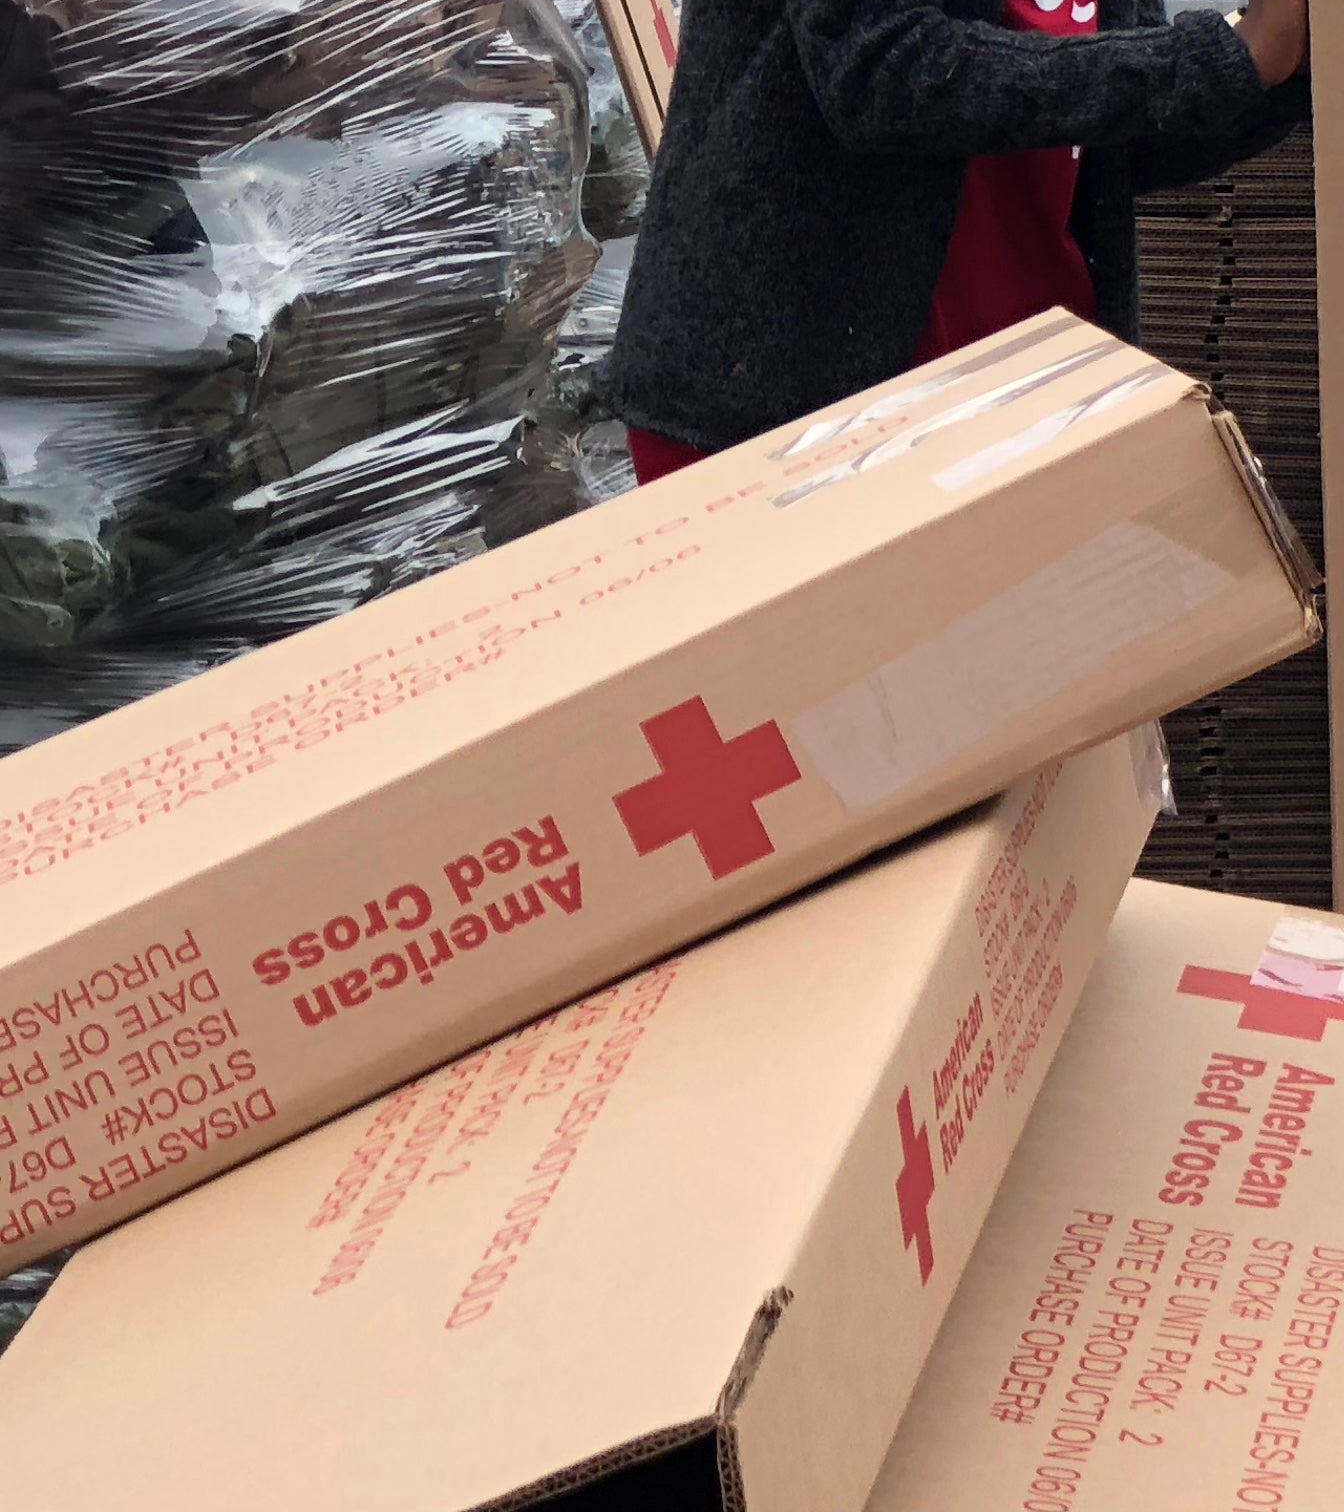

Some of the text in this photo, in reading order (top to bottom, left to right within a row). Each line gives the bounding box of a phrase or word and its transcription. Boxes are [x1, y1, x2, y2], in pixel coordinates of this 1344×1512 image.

[252, 814, 570, 986] Red Cross
[293, 861, 584, 1027] American
[59, 1023, 110, 1071] OF
[115, 968, 220, 1039] DATE
[118, 1008, 239, 1087] ISSUE
[932, 992, 984, 1119] American
[28, 1070, 116, 1137] UNIT
[78, 1087, 277, 1202] DISASTER
[101, 1048, 257, 1146] STOCK#
[938, 1037, 996, 1175] Red Cross
[1158, 1051, 1268, 1208] Red Cross
[1235, 1062, 1335, 1210] American
[1105, 1277, 1152, 1309] OF
[1116, 1218, 1174, 1275] DATE
[1174, 1227, 1234, 1292] ISSUE
[990, 1209, 1114, 1425] PURCHASE ORDER#
[1156, 1294, 1212, 1347] UNIT
[1204, 1238, 1294, 1397] STOCK# D67-2
[1042, 1310, 1140, 1463] PRODUCTION
[1118, 1428, 1164, 1448] 2
